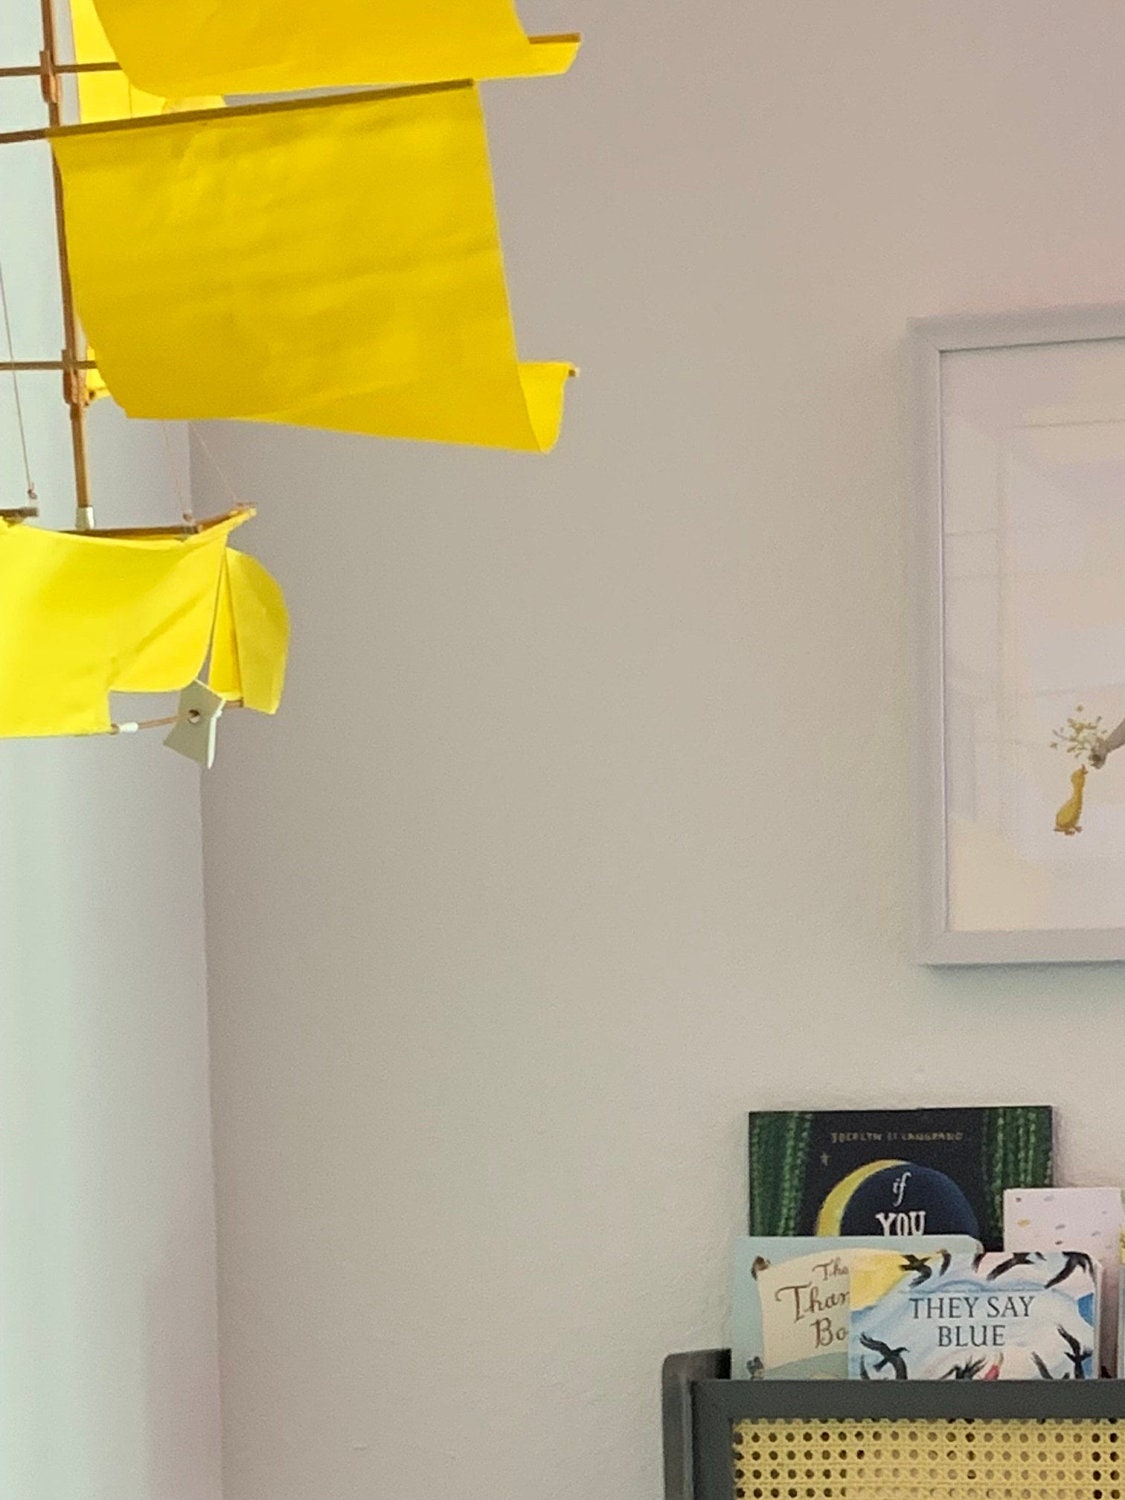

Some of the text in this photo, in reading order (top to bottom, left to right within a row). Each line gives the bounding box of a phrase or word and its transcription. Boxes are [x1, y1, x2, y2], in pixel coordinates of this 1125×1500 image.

[892, 1172, 911, 1206] if
[875, 1210, 926, 1235] YOU
[909, 1296, 1035, 1320] THEY SAY
[937, 1325, 1006, 1348] BLUE
